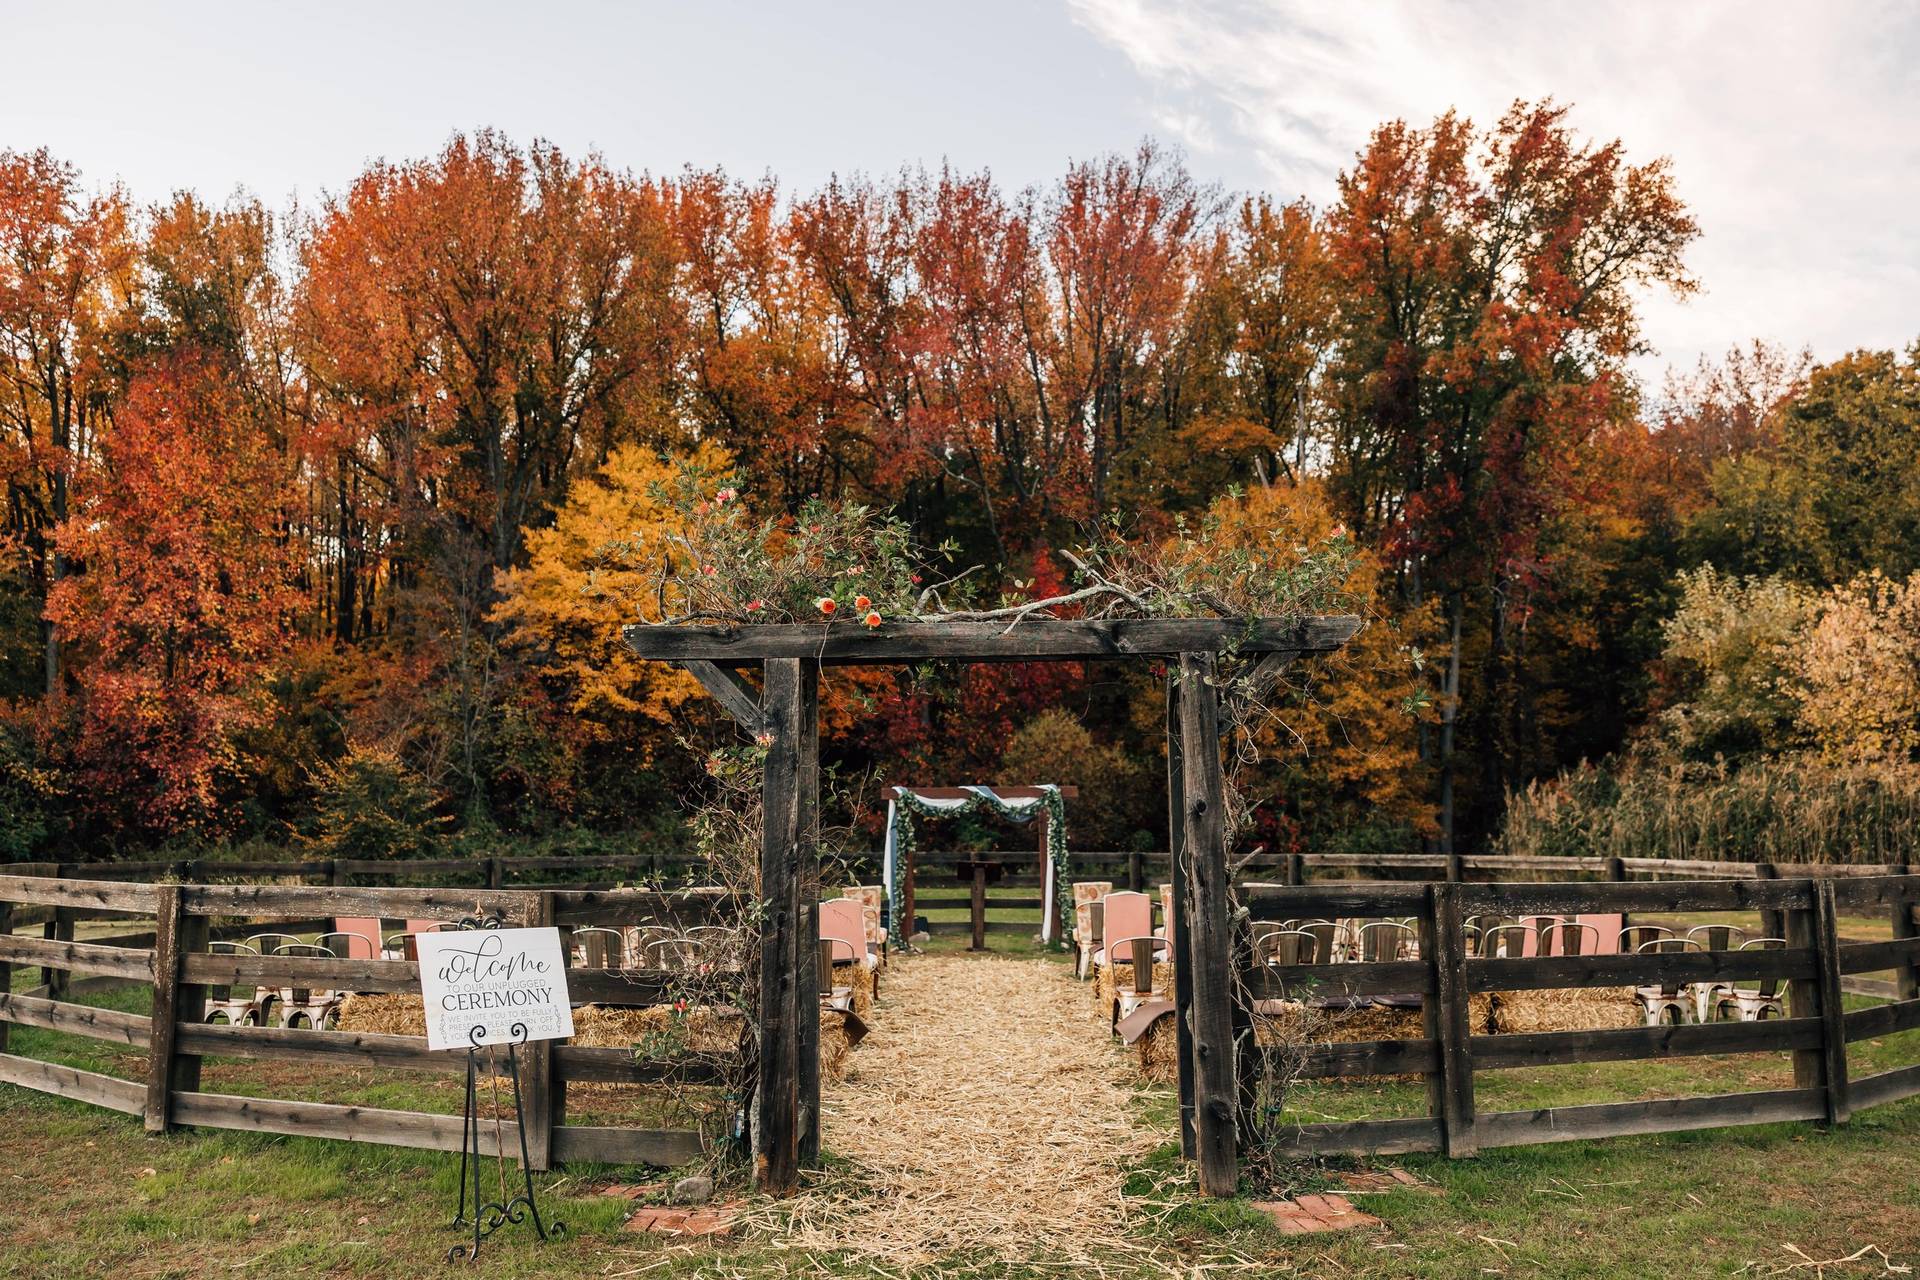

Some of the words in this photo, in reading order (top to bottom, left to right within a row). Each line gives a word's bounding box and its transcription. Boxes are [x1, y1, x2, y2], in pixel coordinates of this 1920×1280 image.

[446, 984, 460, 993] TO
[463, 982, 485, 993] OUR
[487, 979, 546, 990] UNPLUGGED
[442, 987, 552, 1011] CEREMONY
[448, 1015, 461, 1023] WE
[464, 1013, 487, 1022] INVITE
[490, 1011, 506, 1020] YOU
[508, 1010, 518, 1018] TO
[520, 1009, 529, 1017] BE
[532, 1007, 552, 1016] FULLY
[448, 1023, 481, 1032] PRESE
[487, 1019, 513, 1028] PLEASE
[540, 1015, 553, 1024] OFF
